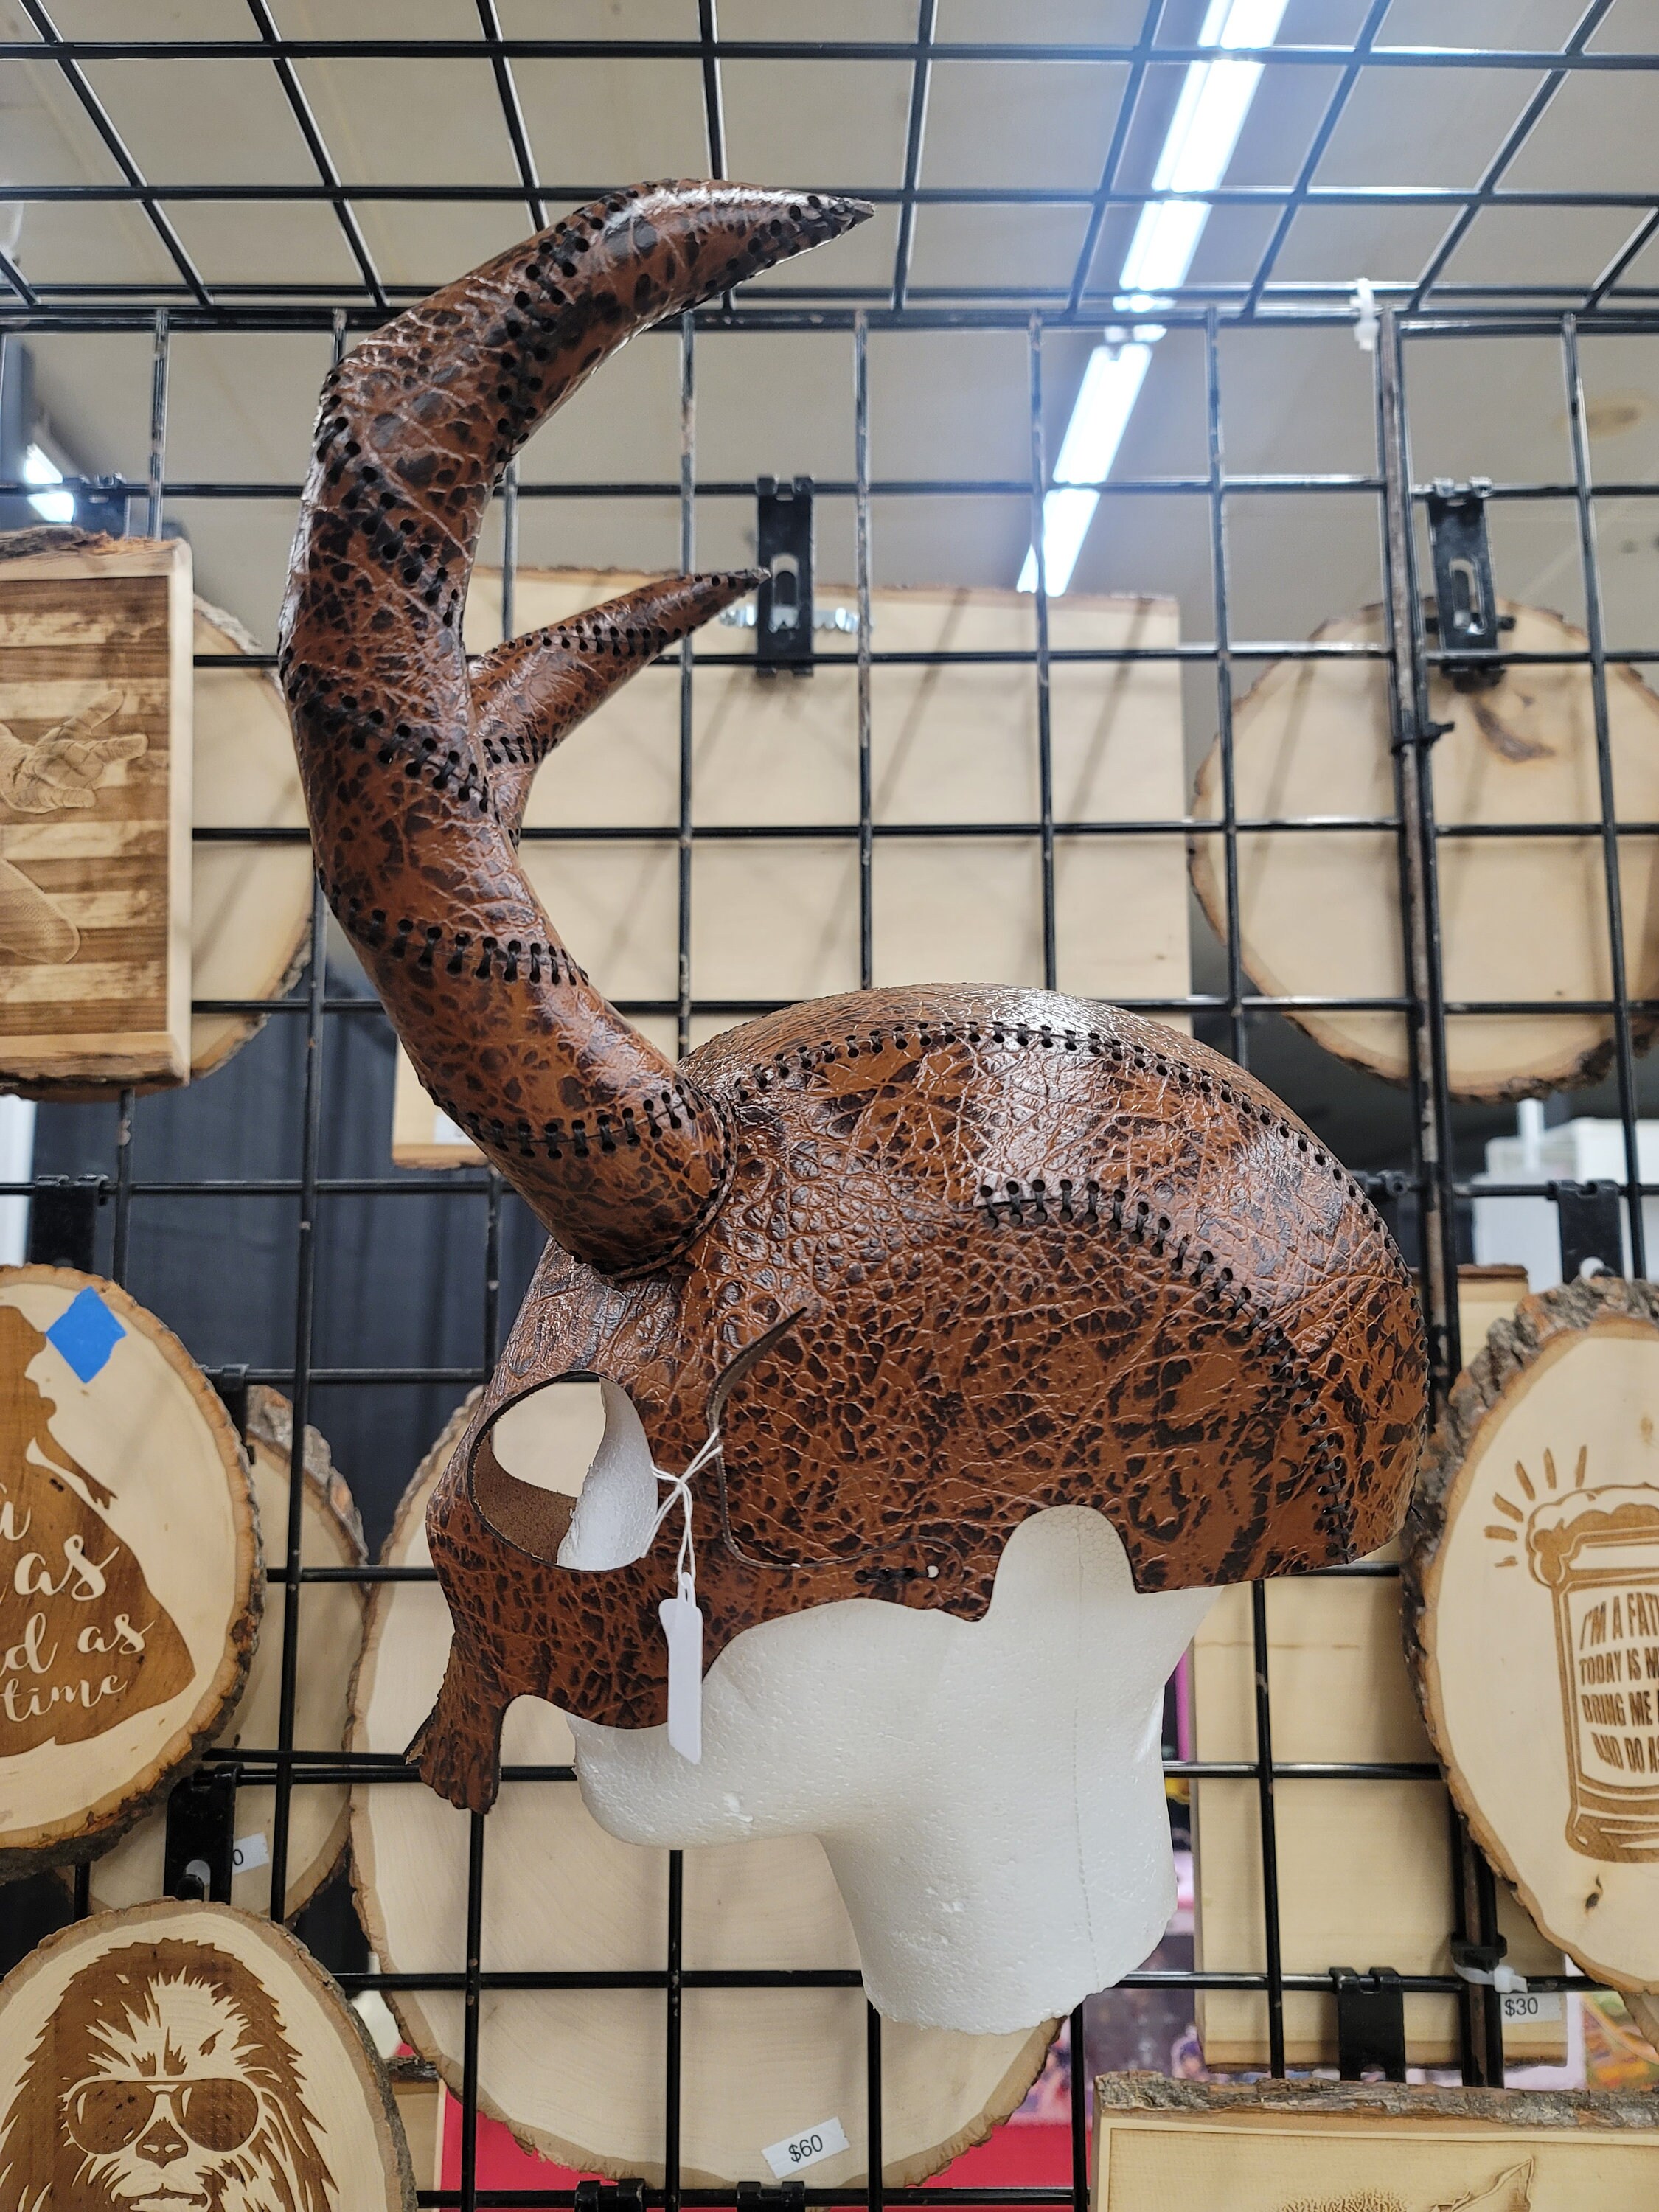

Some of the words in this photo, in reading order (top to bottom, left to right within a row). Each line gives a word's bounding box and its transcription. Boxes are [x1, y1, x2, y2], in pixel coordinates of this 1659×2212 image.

[14, 1534, 120, 1601] as
[77, 1613, 156, 1655] as
[1579, 1601, 1606, 1650] I'M
[1612, 1595, 1623, 1641] A
[1579, 1650, 1621, 1686] TODAY
[1627, 1648, 1641, 1681] IS
[3, 1674, 128, 1722] time
[1581, 1692, 1626, 1727] BRING
[1628, 1691, 1653, 1727] ME
[1624, 1736, 1645, 1774] DO
[1504, 1997, 1539, 2018] $30
[787, 2134, 824, 2163] $60
